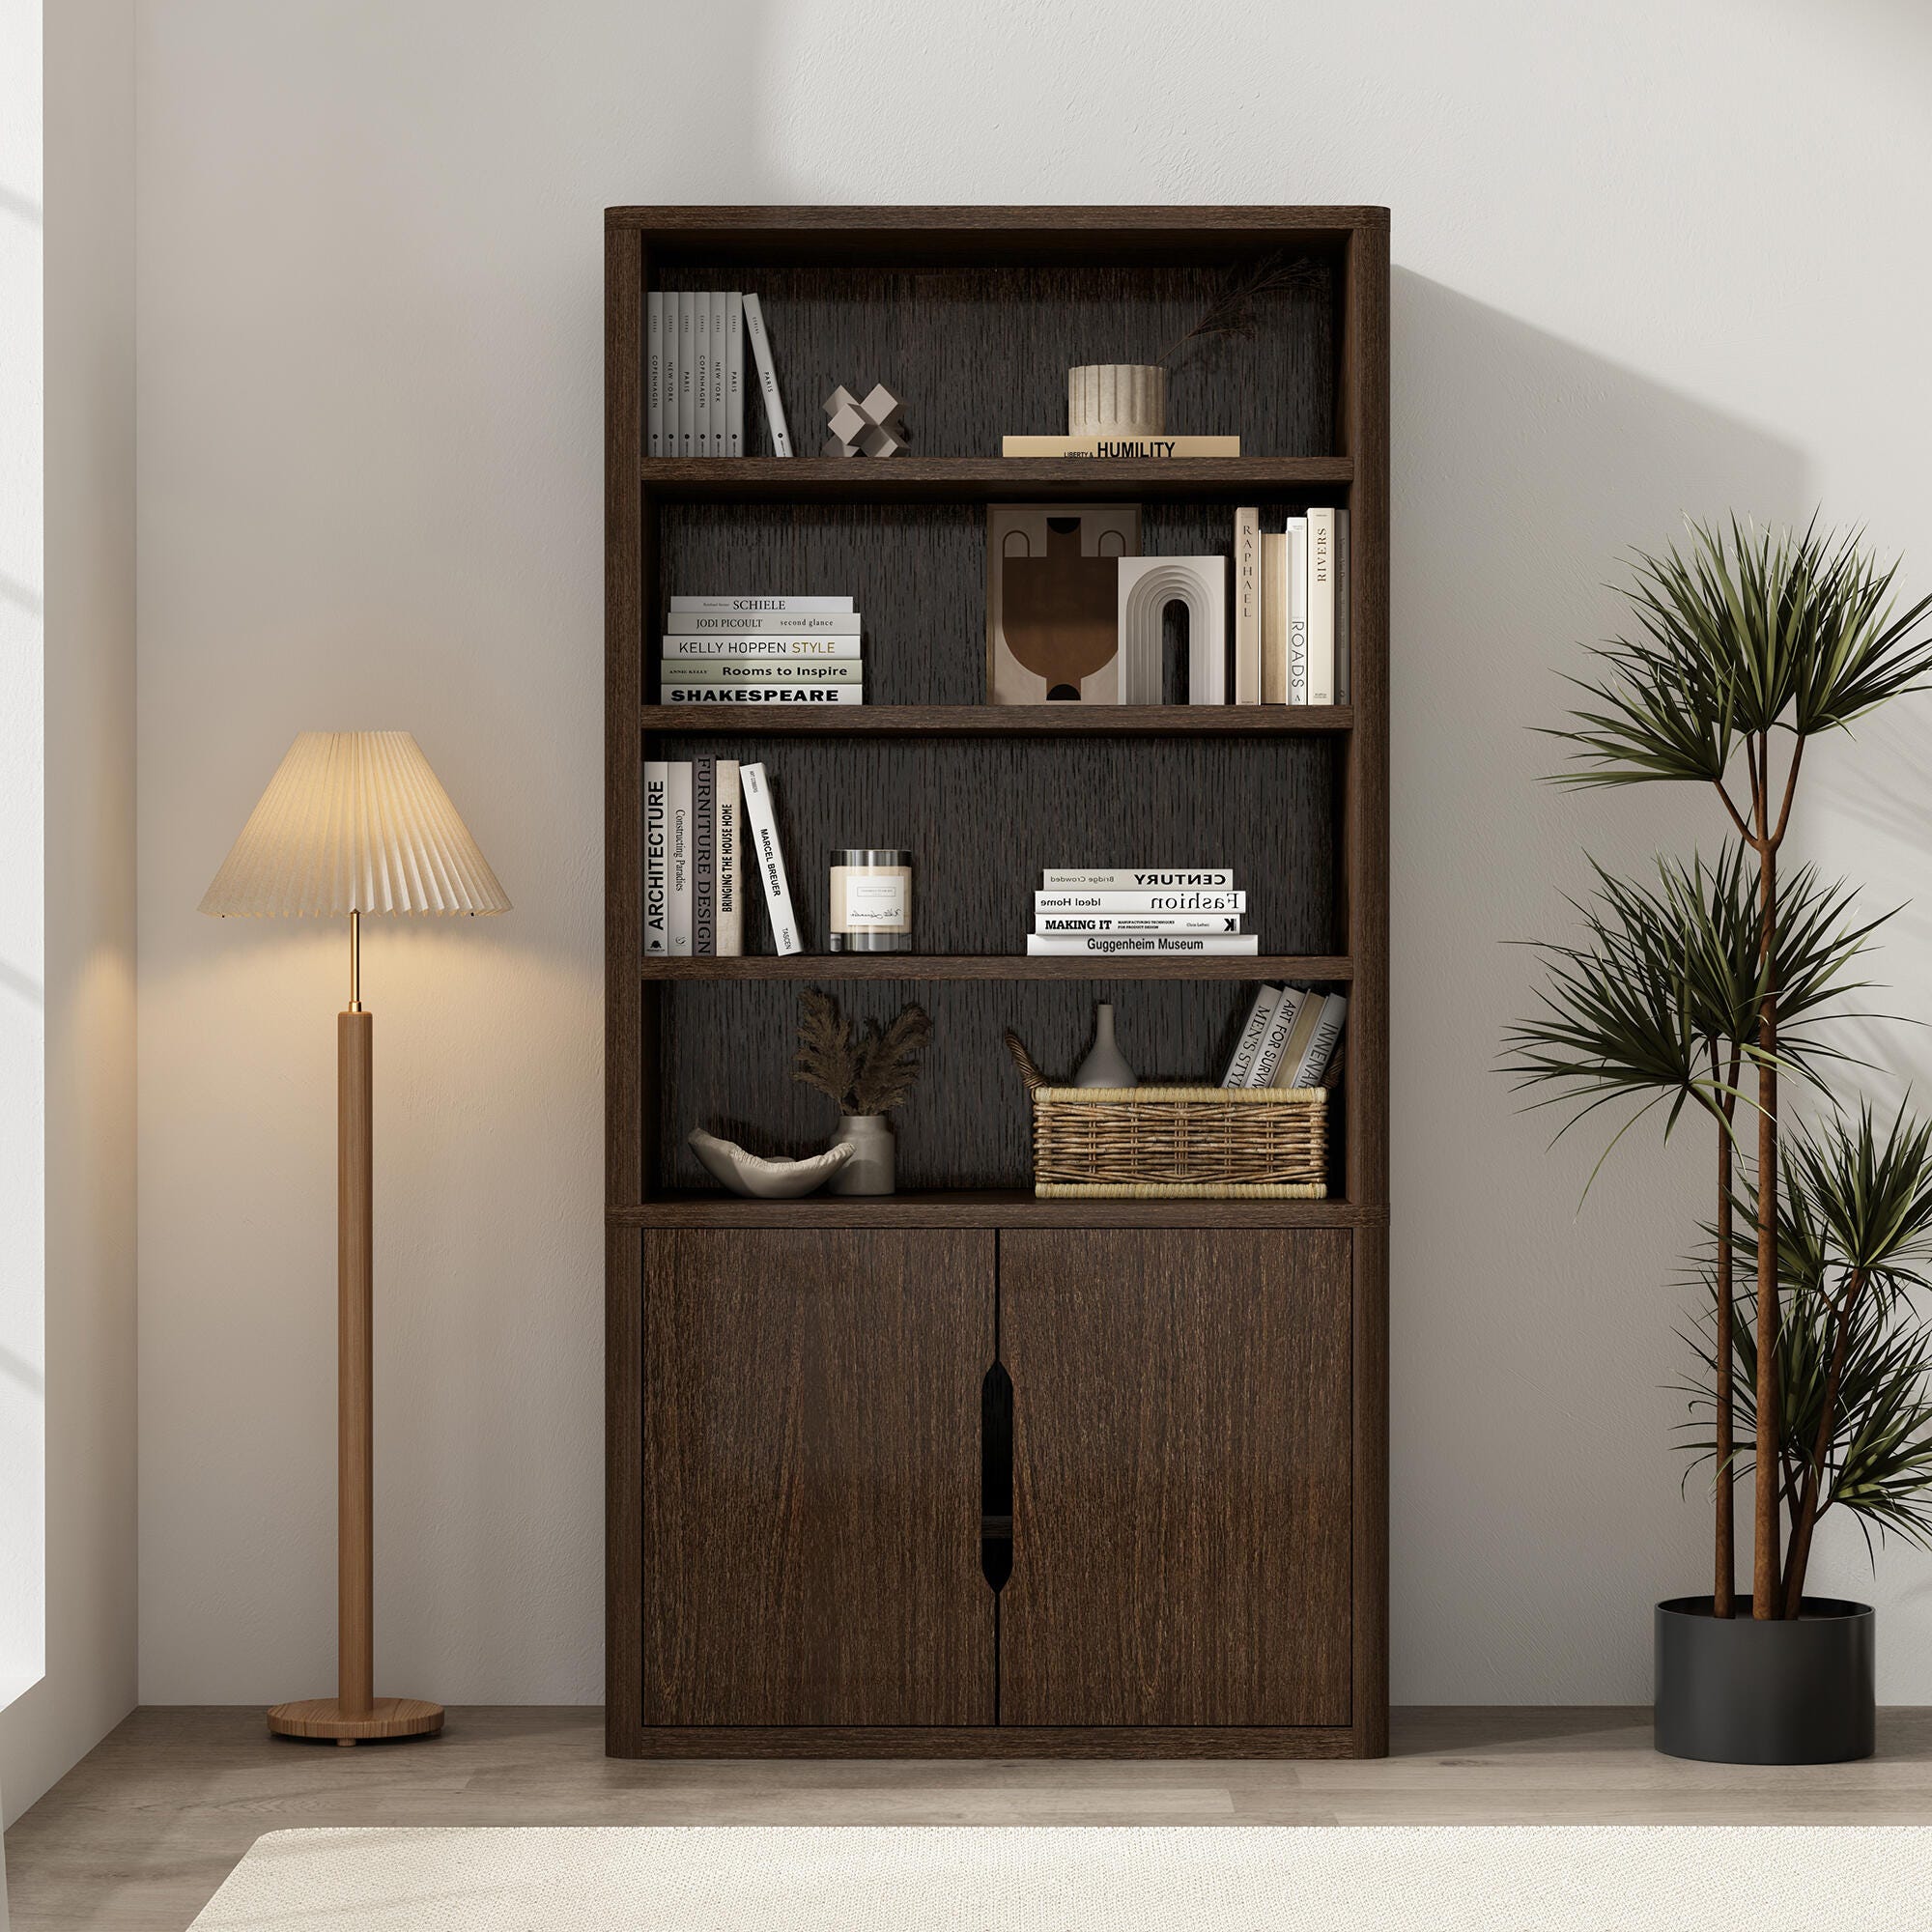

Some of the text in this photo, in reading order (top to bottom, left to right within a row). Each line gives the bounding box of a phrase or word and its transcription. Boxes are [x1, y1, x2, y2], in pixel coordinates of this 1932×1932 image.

[1097, 442, 1176, 457] HUMILITY
[1317, 527, 1326, 582] RIVERS
[1242, 526, 1253, 617] RAPHAEL
[733, 600, 786, 611] SCHIELE
[696, 618, 763, 629] JODI PICOULT
[809, 618, 834, 627] glance
[679, 641, 836, 653] KELLY HOPPEN STYLE
[1292, 620, 1305, 688] ROADS
[723, 667, 848, 678] Rooms to Inspire
[670, 690, 838, 701] SHAKESPEARE
[673, 810, 686, 858] Constructing
[647, 781, 665, 931] ARCHITECTURE
[697, 758, 711, 954] FURNITURE DESIGN
[722, 804, 732, 912] BRINGING THE HOUSE HOME
[760, 828, 781, 897] MARCEL BREUER
[1045, 920, 1112, 930] MAKING IT
[1087, 938, 1204, 952] Guggenheim Museum
[1279, 999, 1296, 1023] ART
[1243, 1005, 1270, 1052] MEN'S
[1267, 1024, 1287, 1049] FOR
